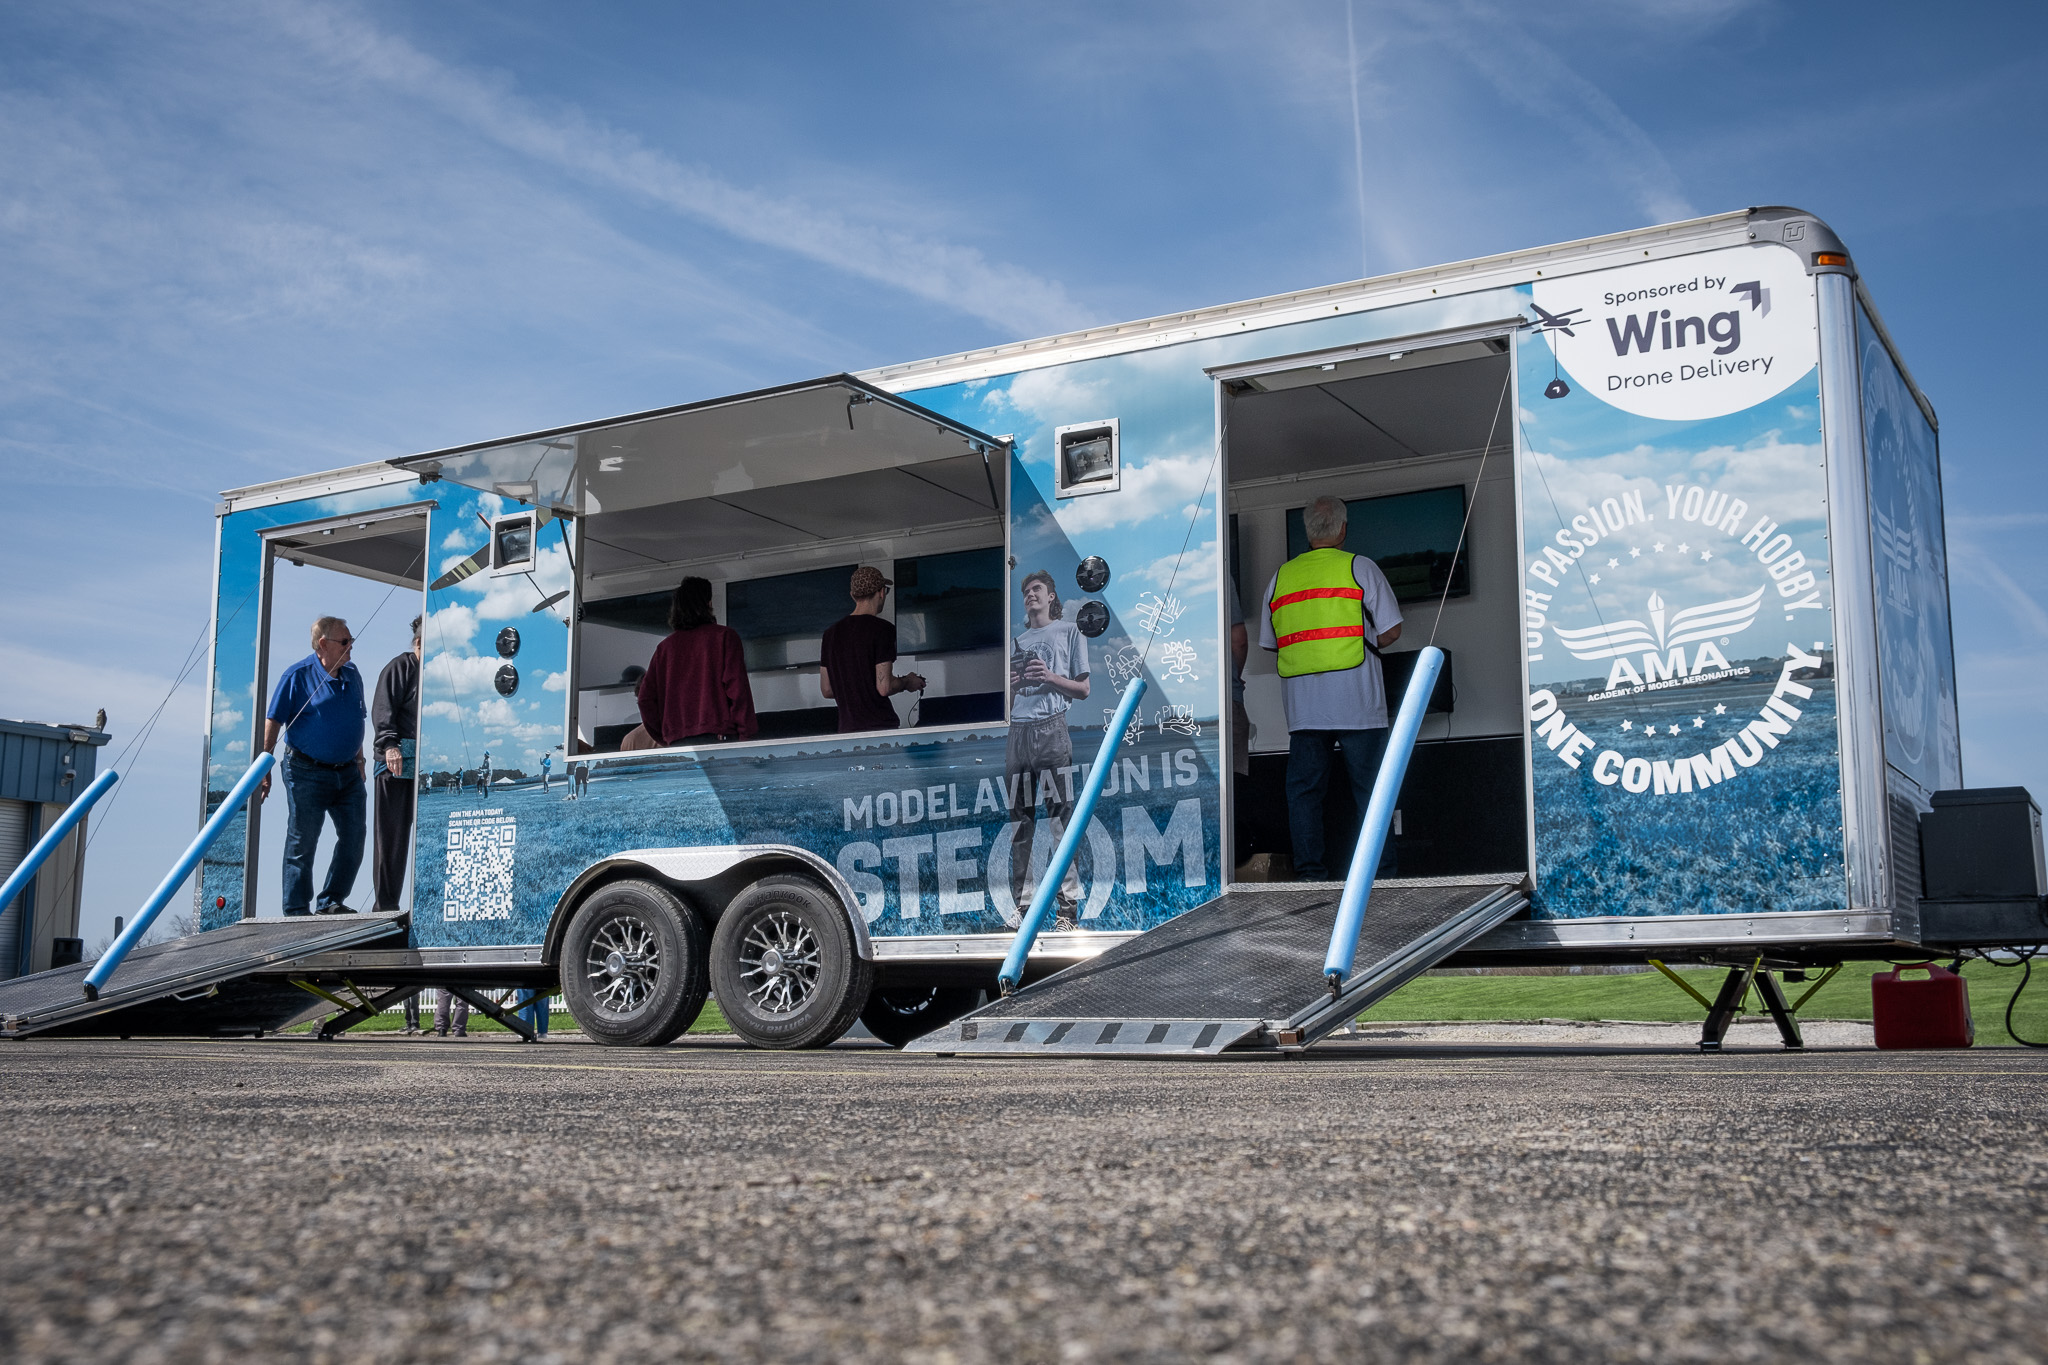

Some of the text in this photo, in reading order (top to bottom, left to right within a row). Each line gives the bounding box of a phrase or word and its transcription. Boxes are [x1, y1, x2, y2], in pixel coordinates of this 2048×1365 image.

[1604, 275, 1727, 307] Sponsored by
[1605, 309, 1741, 357] Wing
[1608, 356, 1774, 391] Drone Delivery
[1528, 488, 1654, 588] PASSION.
[1665, 484, 1749, 537] YOUR
[1740, 515, 1823, 622] HOBBY.
[1163, 639, 1194, 655] DRAG
[1587, 666, 1751, 703] ACADEMY OF MODEL AERONAUTICS
[1605, 641, 1732, 692] AMA
[1162, 703, 1194, 719] PITCH
[1530, 688, 1596, 770] ONE
[1592, 641, 1824, 796] COMMUNITY.
[843, 783, 969, 832] MODEL
[1161, 748, 1199, 789] IS
[448, 819, 462, 827] SCAN
[473, 818, 481, 826] QR
[482, 817, 495, 825] CODE
